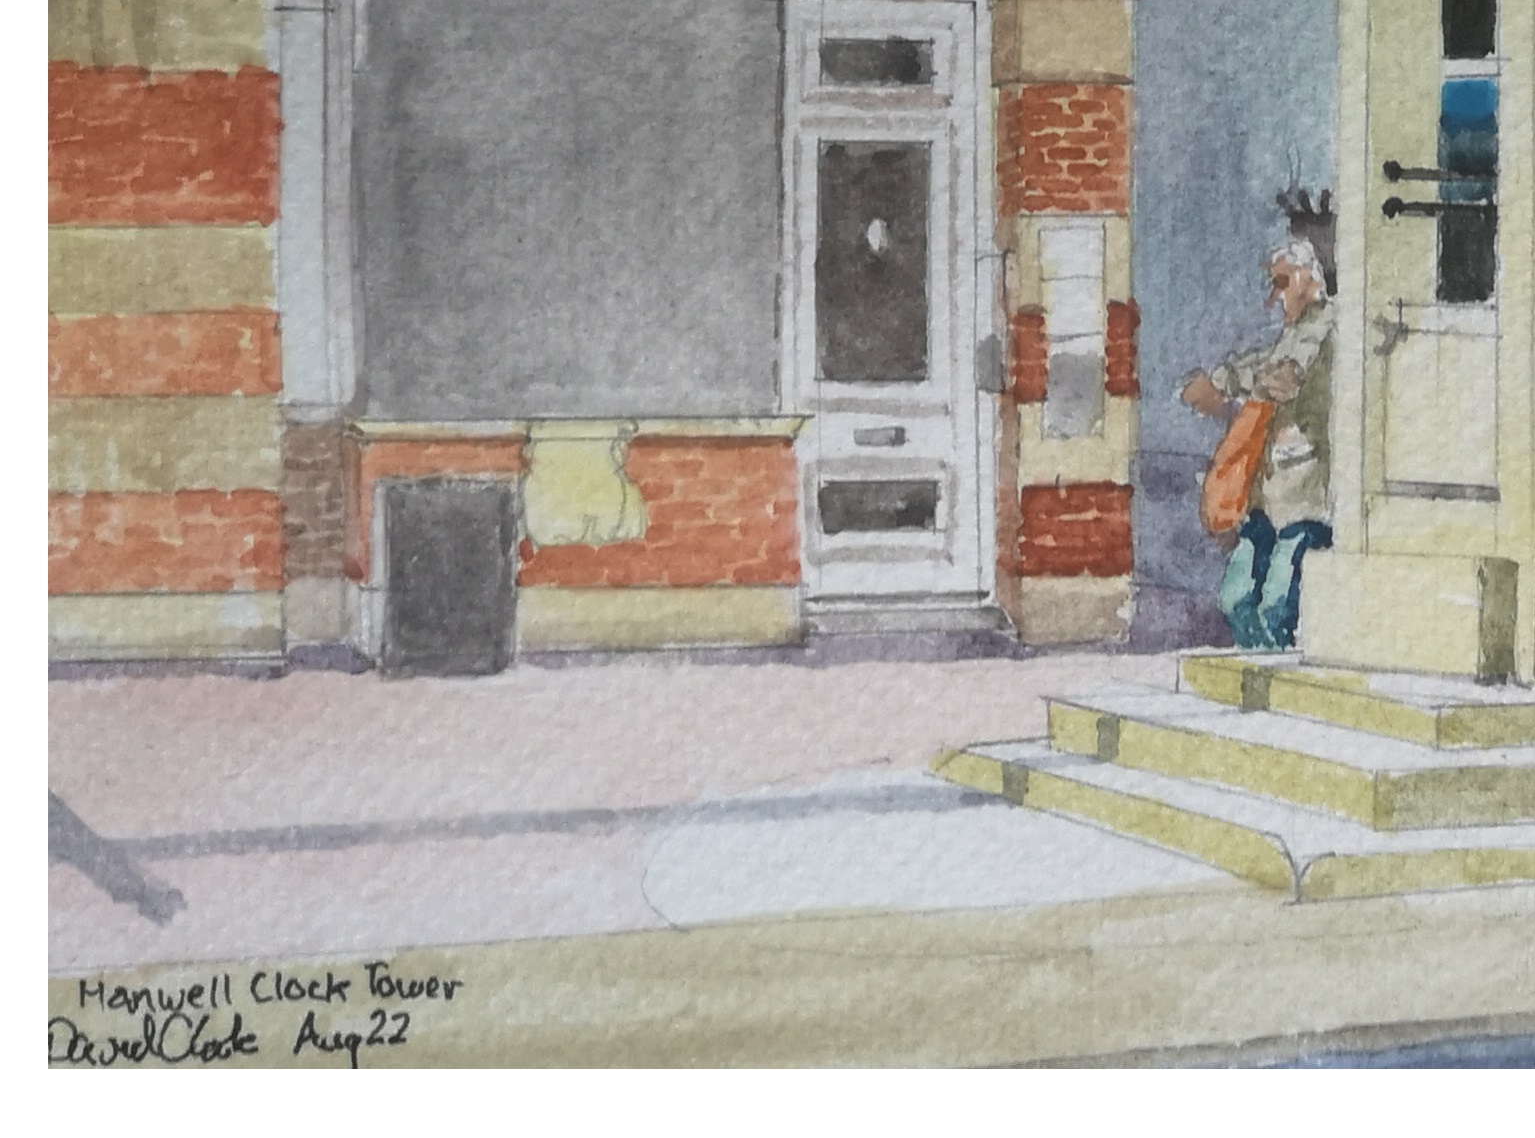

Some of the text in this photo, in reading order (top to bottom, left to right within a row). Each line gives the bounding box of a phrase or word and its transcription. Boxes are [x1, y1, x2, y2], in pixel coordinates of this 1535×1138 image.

[79, 961, 464, 1013] Hanwell Clock Tower
